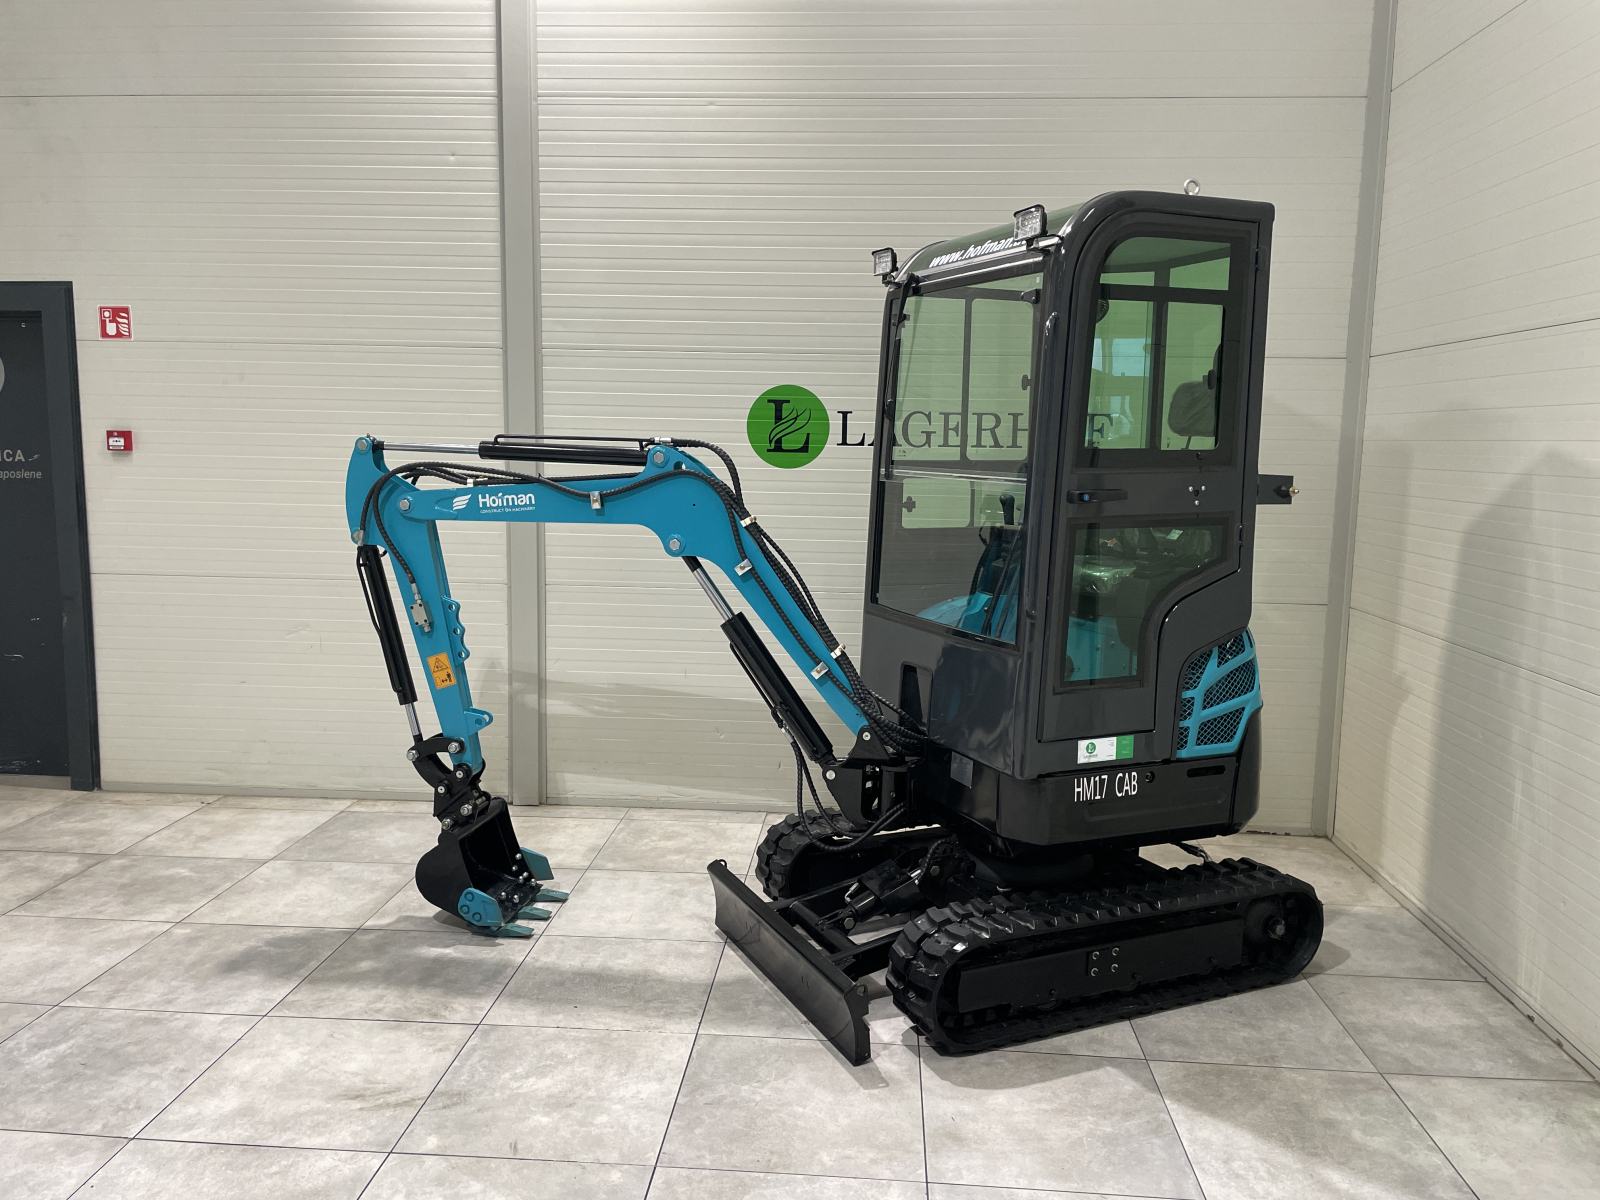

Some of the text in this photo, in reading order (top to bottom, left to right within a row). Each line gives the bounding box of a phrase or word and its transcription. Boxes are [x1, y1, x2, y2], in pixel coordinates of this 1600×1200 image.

[836, 409, 1114, 449] LGERHF
[1074, 771, 1138, 802] HM17 CAB
